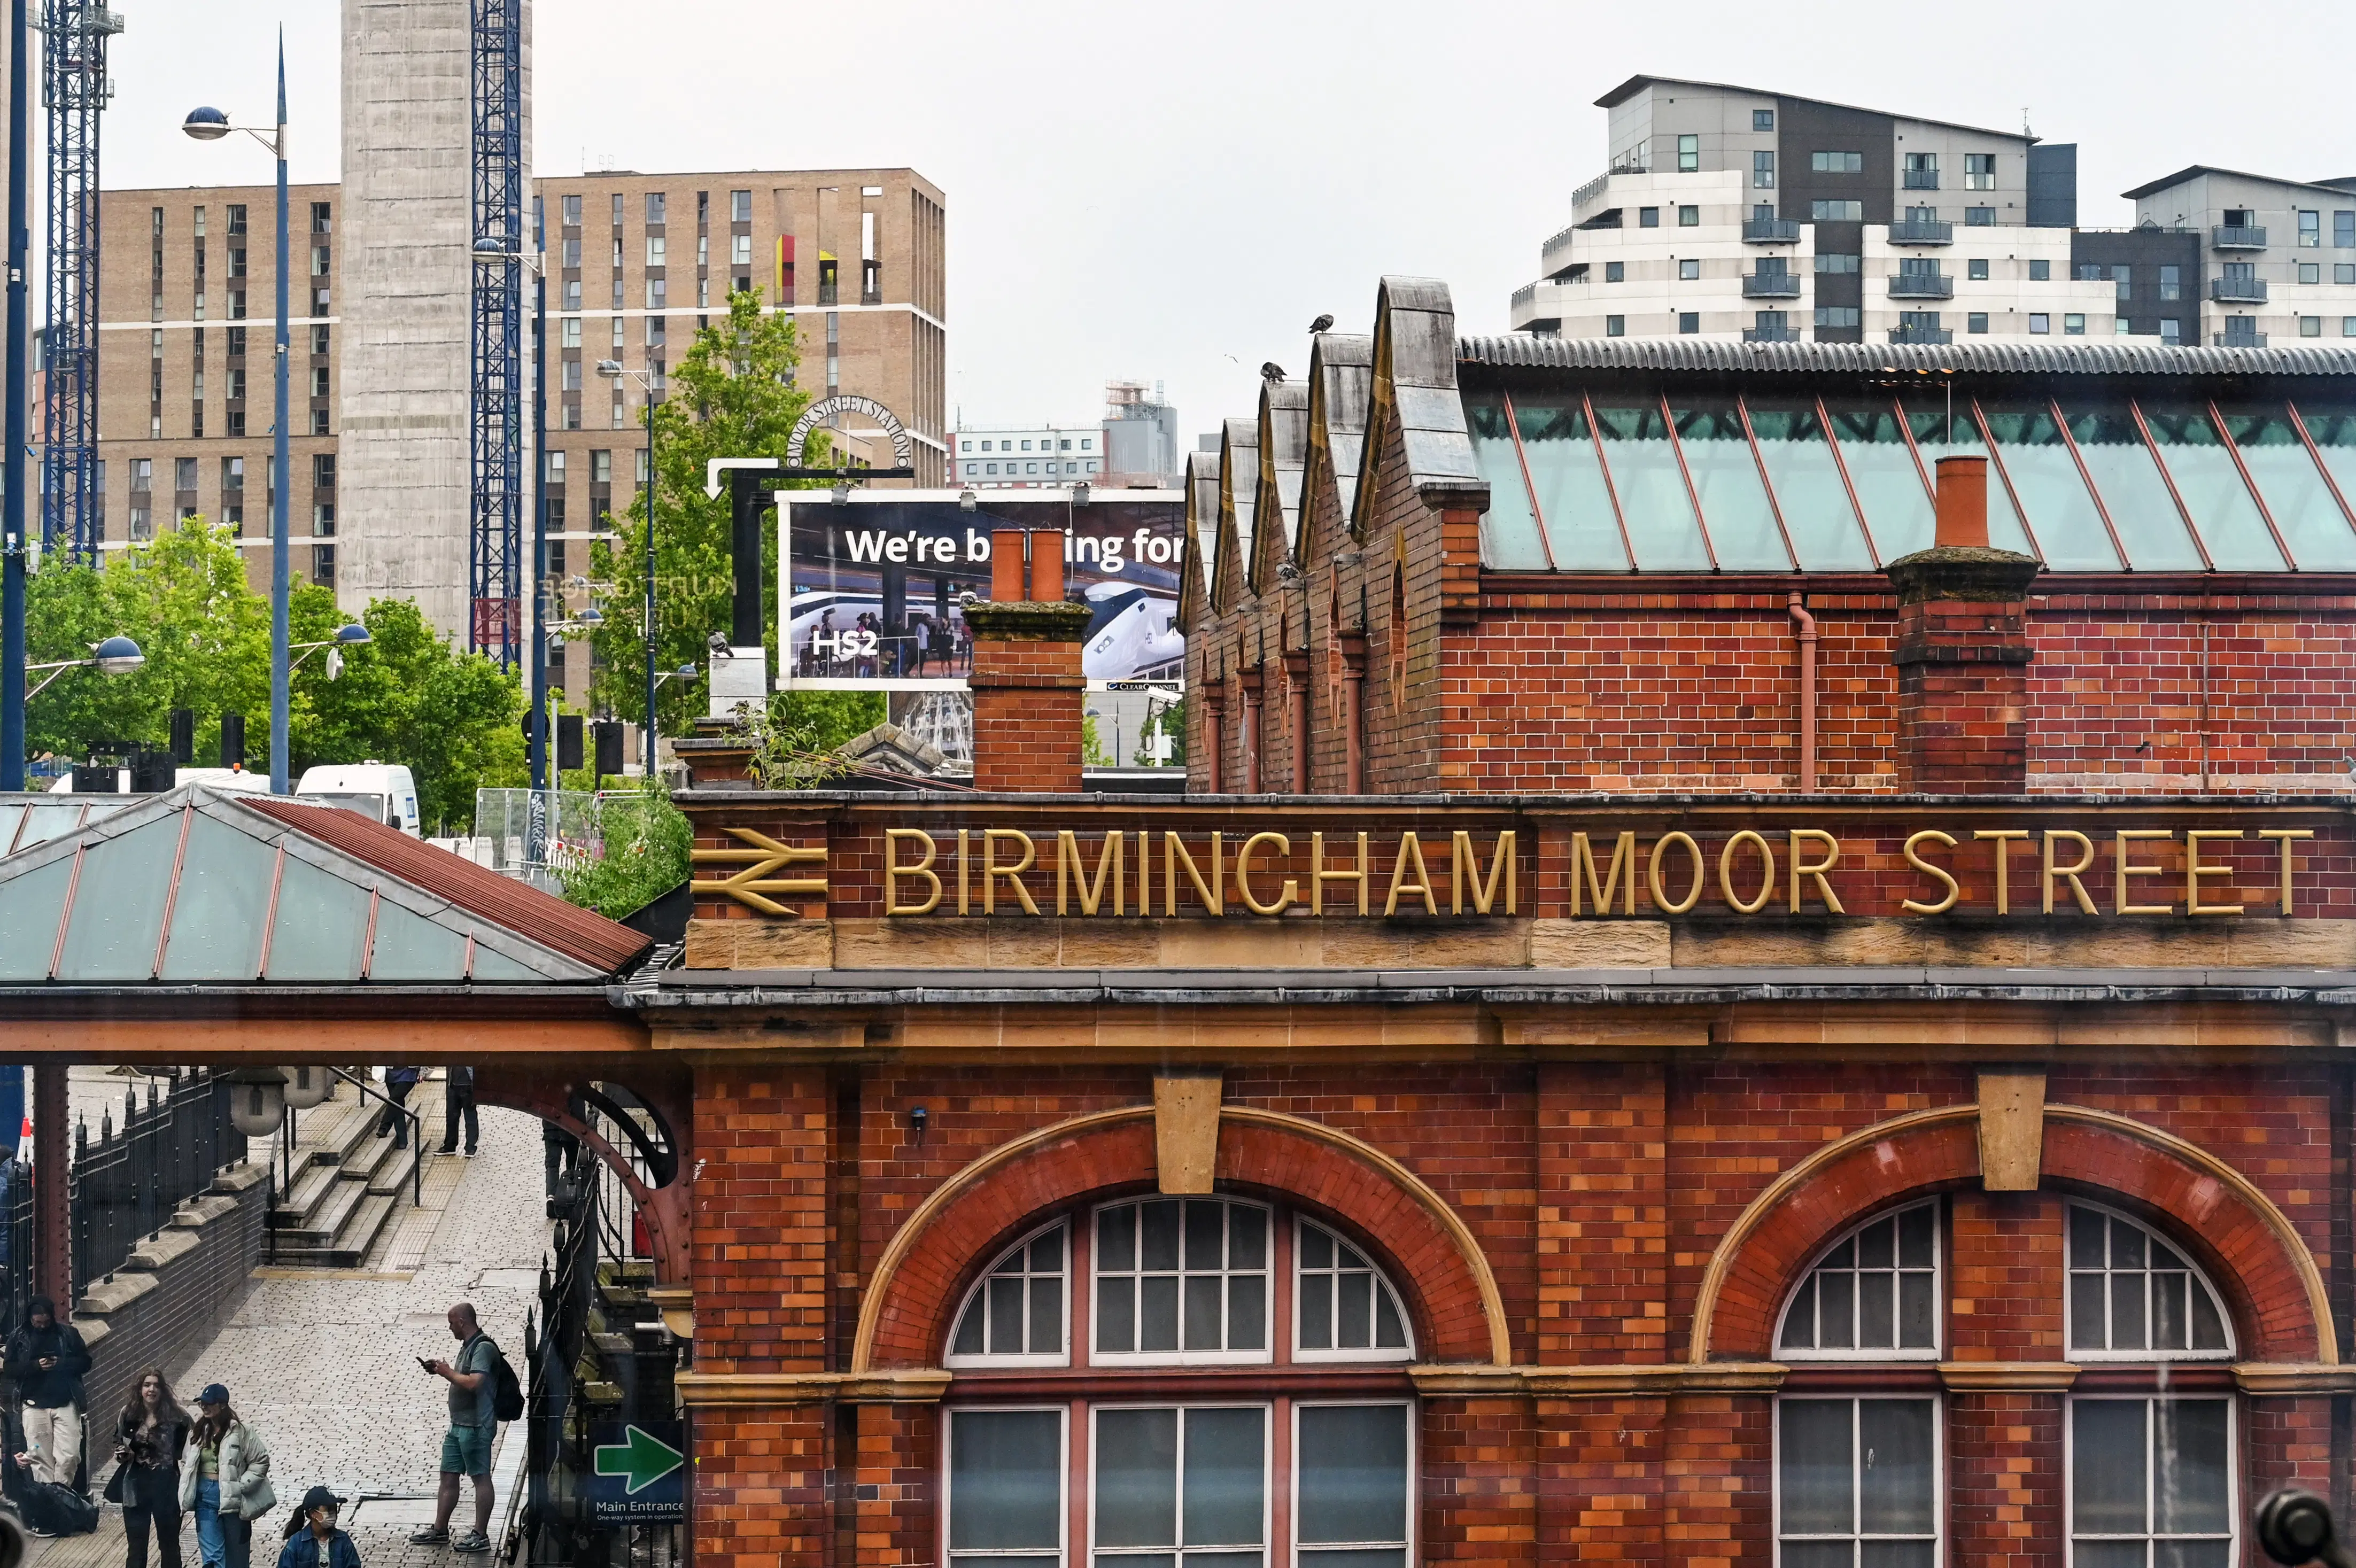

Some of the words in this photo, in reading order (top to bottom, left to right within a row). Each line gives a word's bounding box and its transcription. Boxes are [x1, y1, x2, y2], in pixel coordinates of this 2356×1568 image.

[787, 414, 816, 457] MOOR
[813, 396, 868, 420] STREET
[867, 402, 910, 457] STATION
[845, 530, 956, 562] We're
[813, 630, 878, 656] HS2
[886, 828, 1516, 918] BIRMINGHAM
[1570, 829, 1846, 917] MOOR
[1901, 829, 2315, 917] STREET
[596, 1501, 626, 1511] Main
